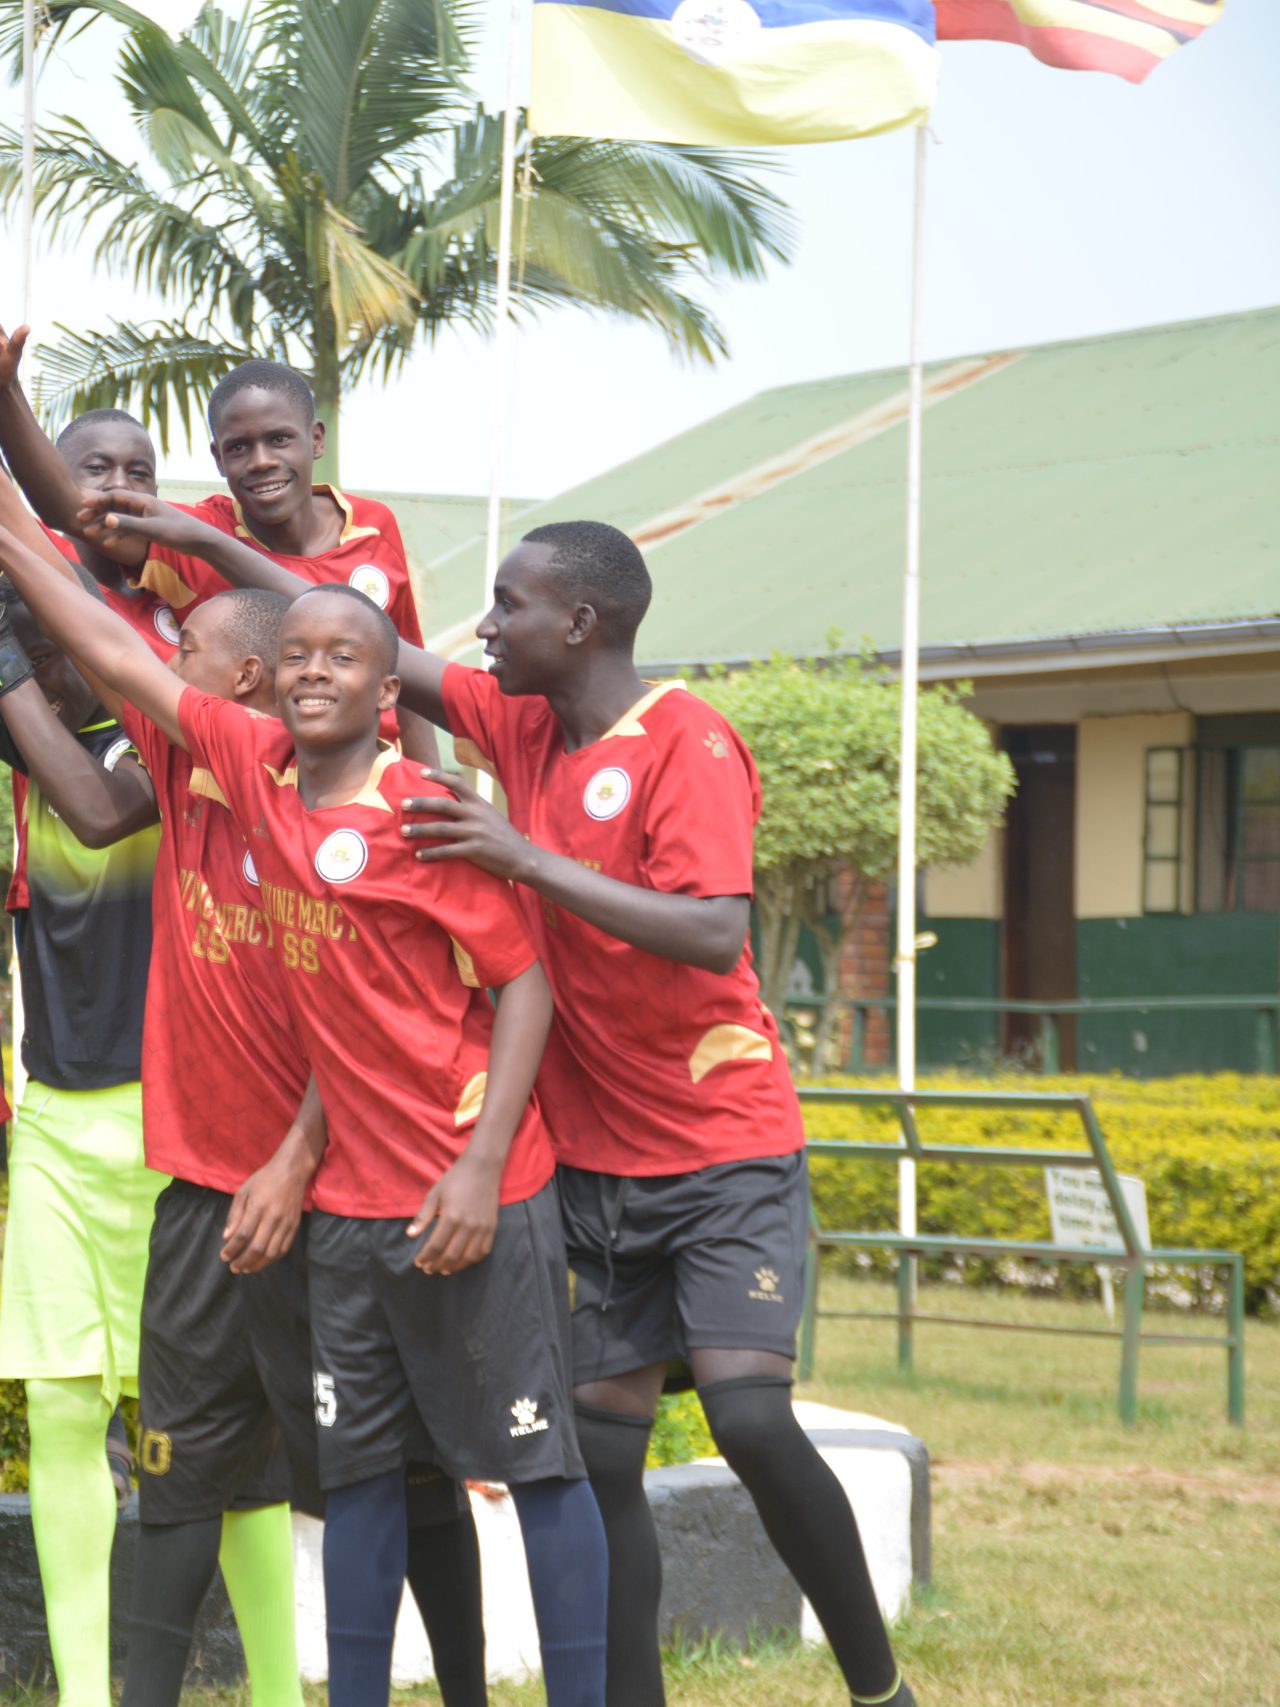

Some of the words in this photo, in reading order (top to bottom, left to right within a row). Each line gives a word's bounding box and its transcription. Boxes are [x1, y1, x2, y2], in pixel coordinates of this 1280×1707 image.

[282, 931, 320, 975] SS
[312, 1371, 337, 1428] 5
[137, 1426, 172, 1477] 0
[509, 1418, 549, 1438] KELME
